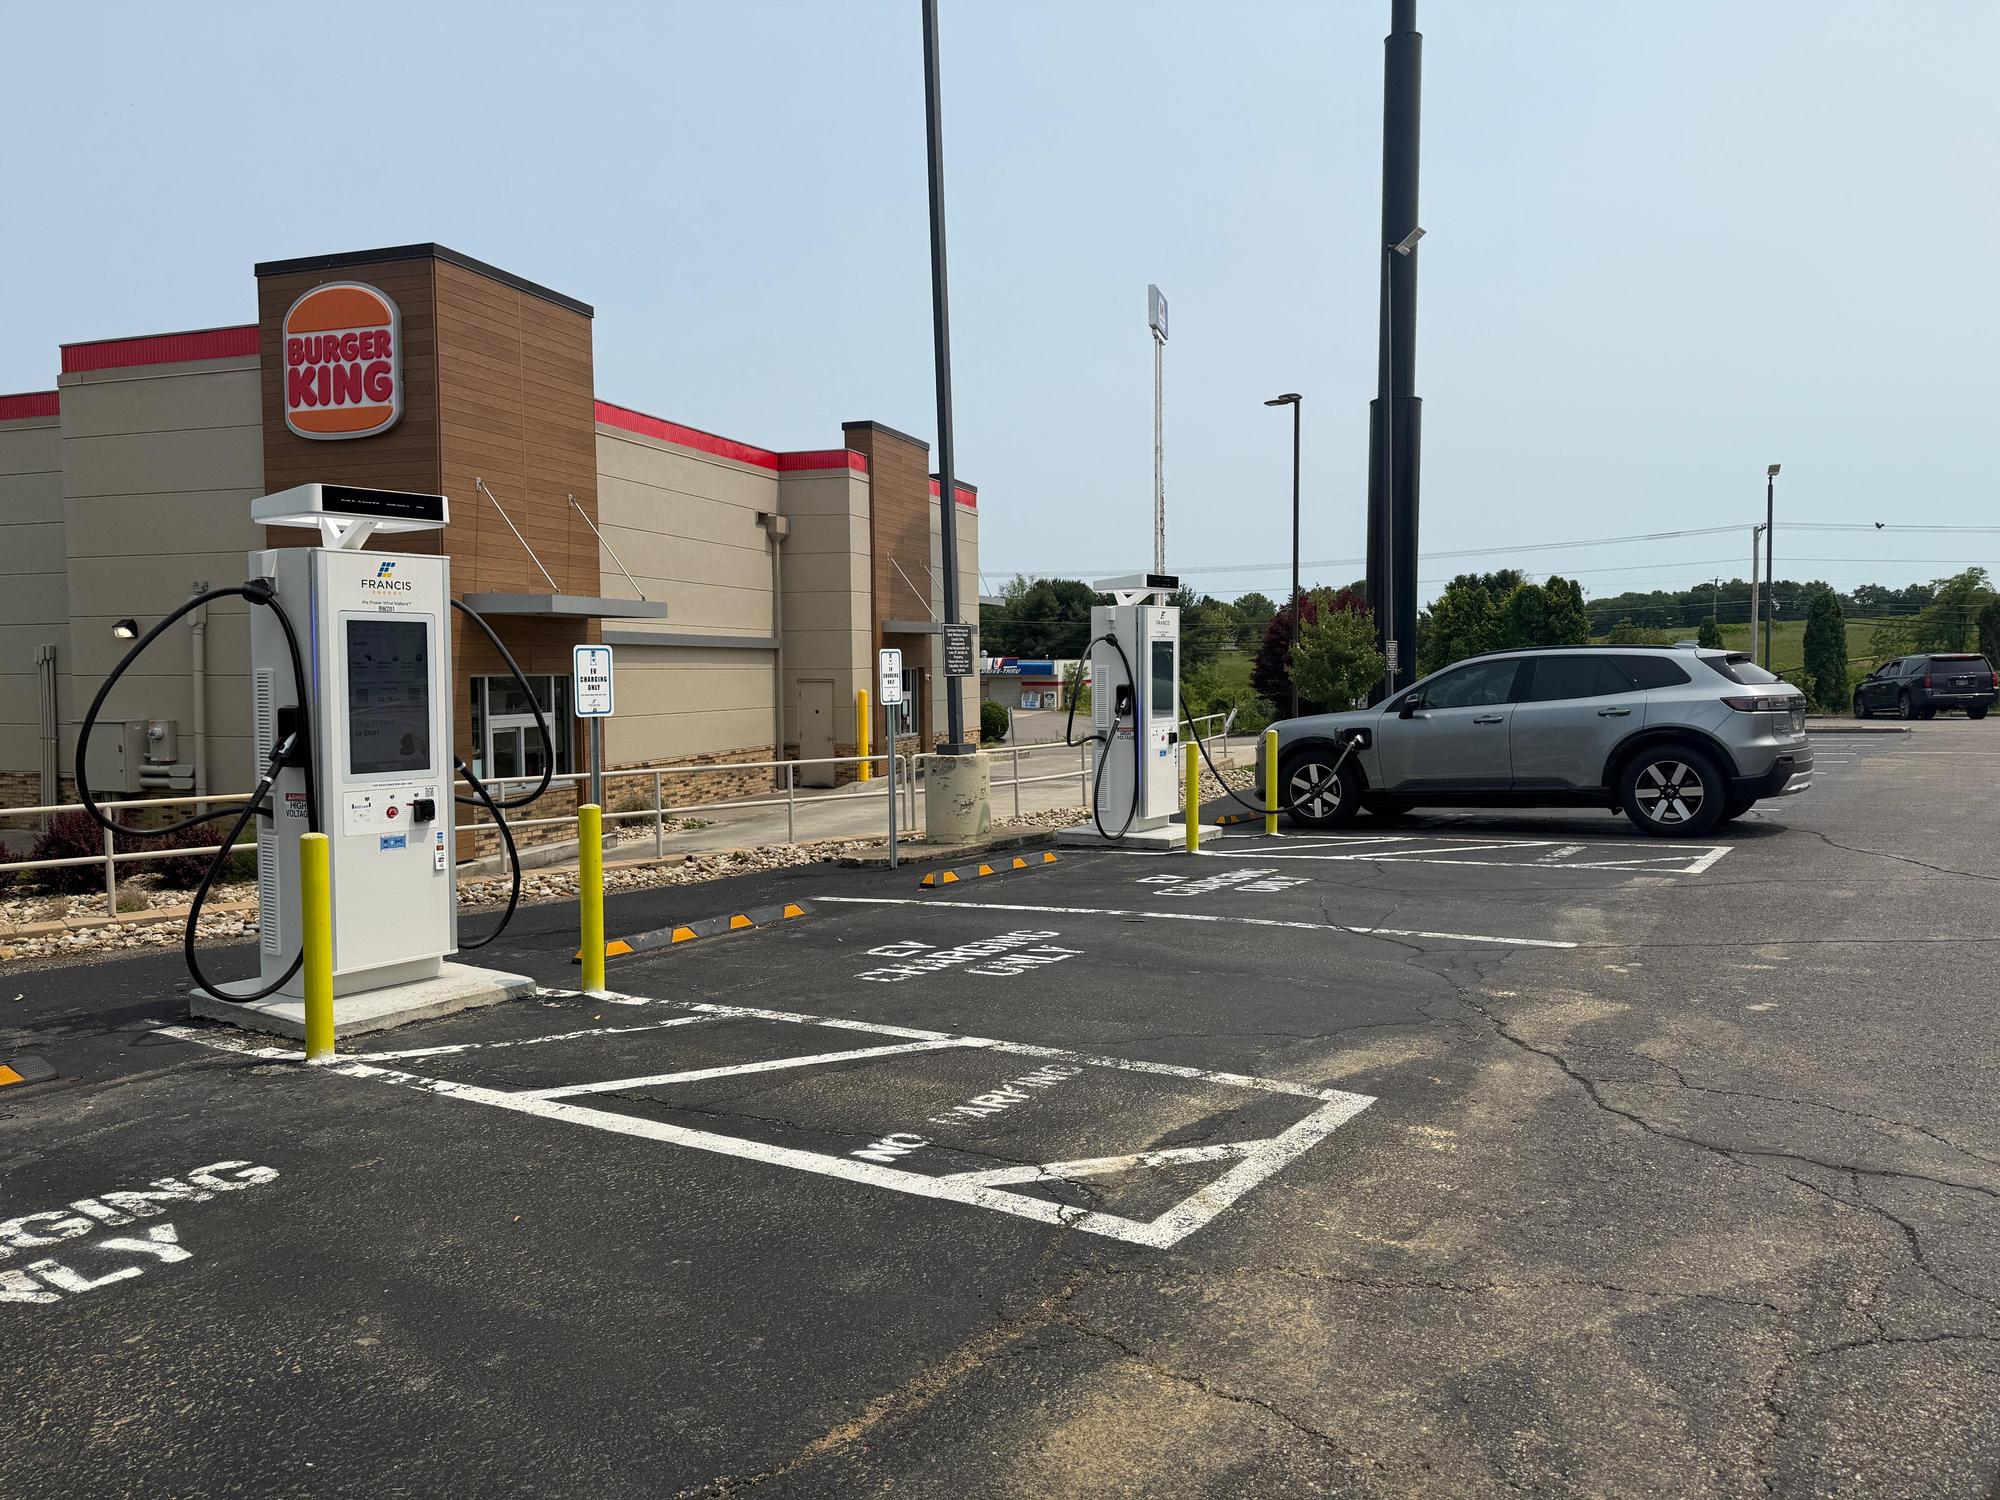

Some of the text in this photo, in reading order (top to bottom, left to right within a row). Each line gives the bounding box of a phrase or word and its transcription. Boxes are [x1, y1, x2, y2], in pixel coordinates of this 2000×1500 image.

[287, 329, 392, 366] BURGER
[288, 360, 393, 408] KING
[361, 579, 412, 591] FRANCIS
[286, 809, 308, 818] VOLTAG
[290, 801, 307, 810] HIGH
[1153, 868, 1279, 896] CHARGING
[1234, 876, 1314, 892] ONLY
[853, 930, 1060, 982] CHARGING
[866, 940, 937, 957] EV
[964, 945, 1085, 976] ONLY
[850, 1133, 930, 1162] NO
[0, 1160, 280, 1259] GING
